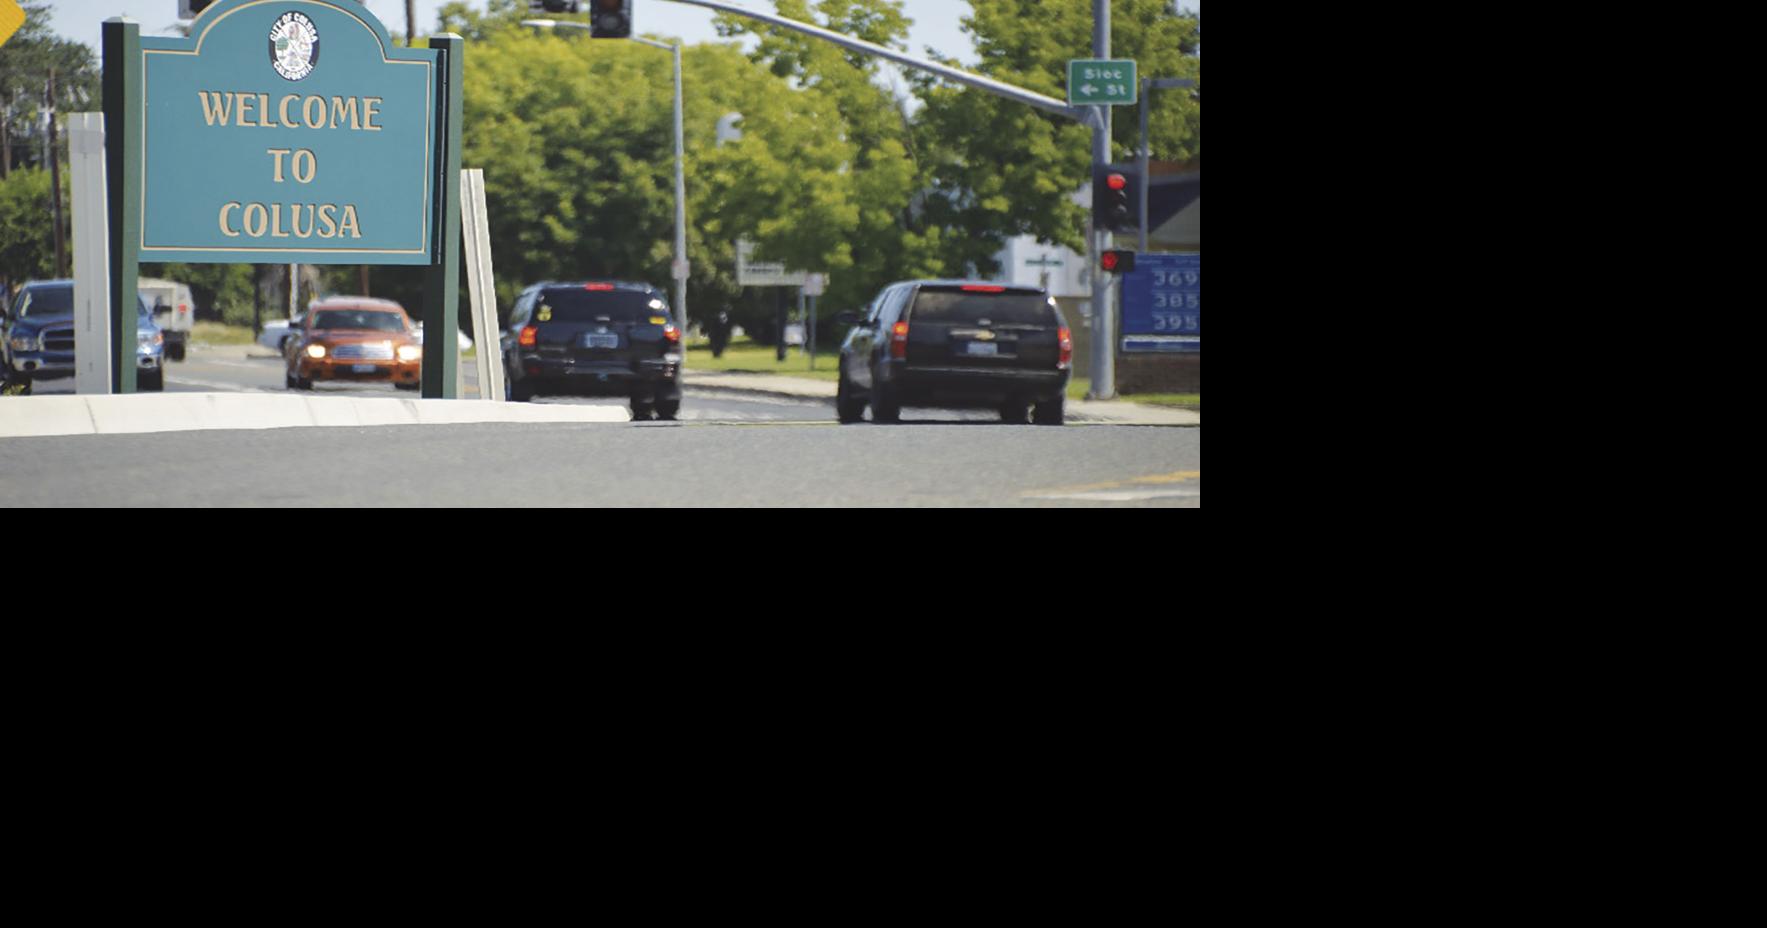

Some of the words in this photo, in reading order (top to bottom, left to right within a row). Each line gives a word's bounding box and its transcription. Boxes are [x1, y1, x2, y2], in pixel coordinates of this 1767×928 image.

[1105, 84, 1126, 96] St
[198, 91, 383, 131] WELCOME
[267, 148, 317, 183] TO
[219, 201, 362, 238] COLUSA
